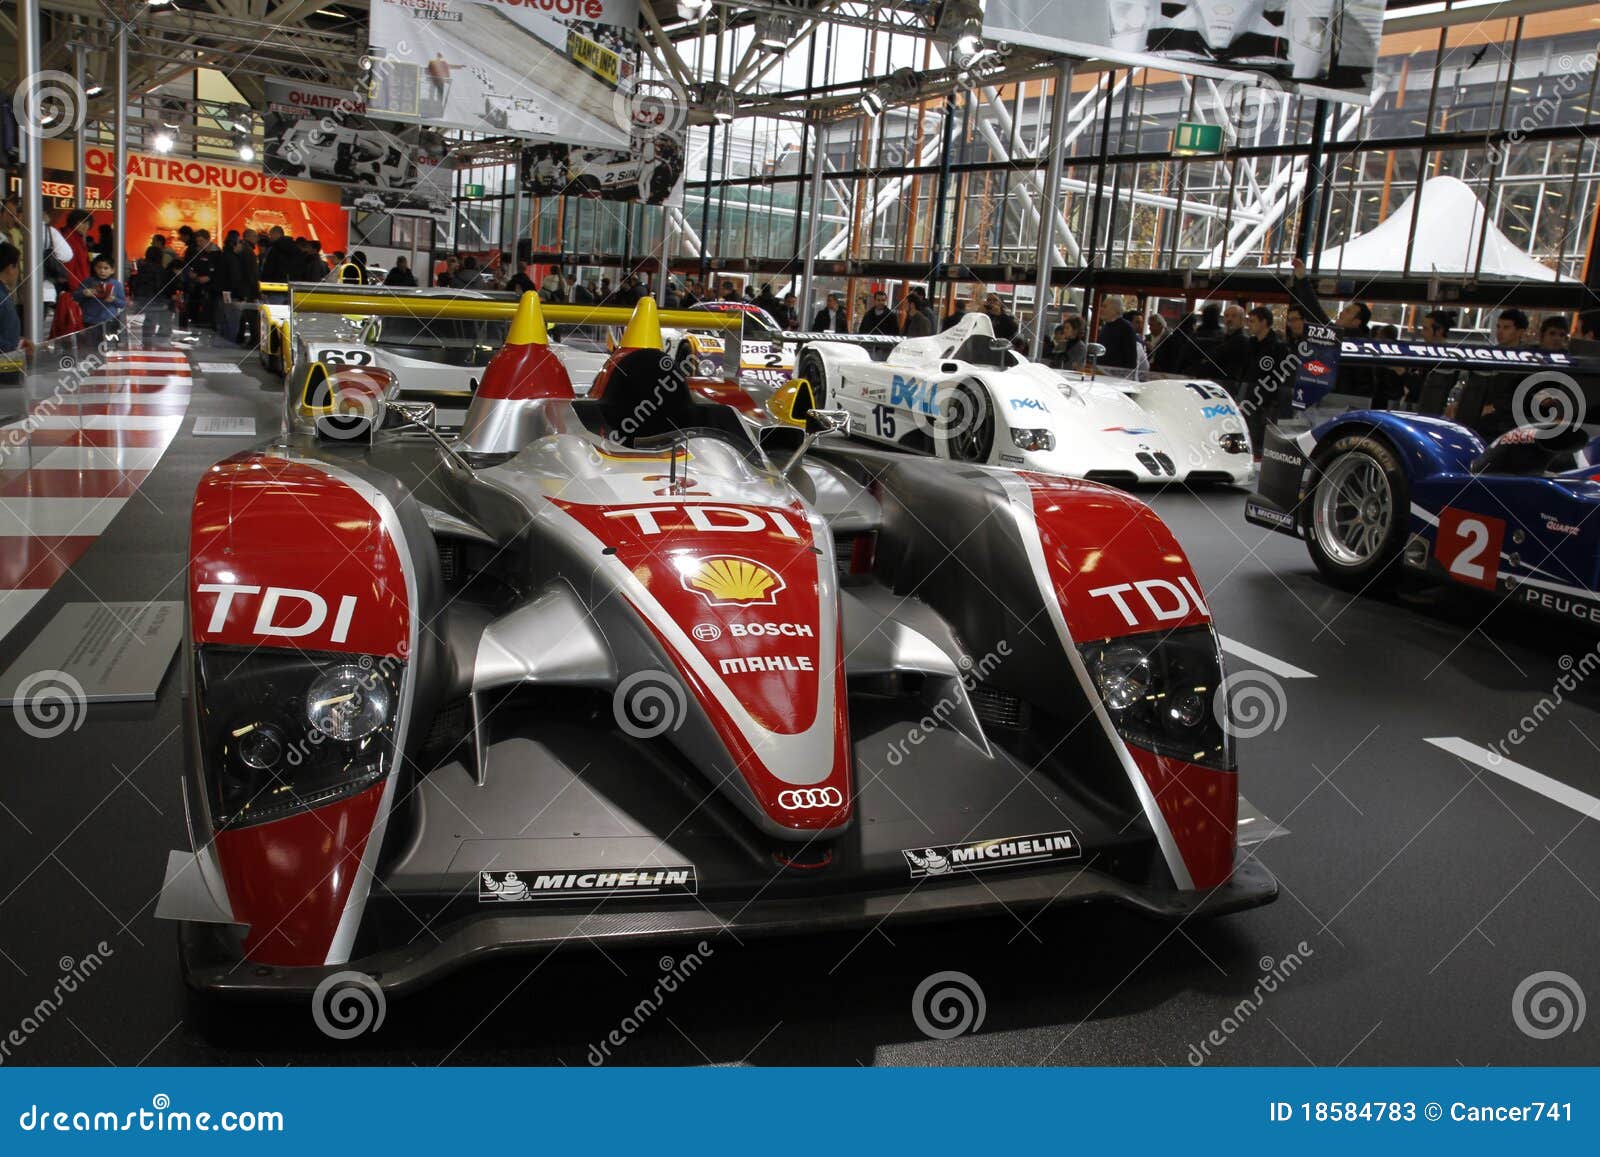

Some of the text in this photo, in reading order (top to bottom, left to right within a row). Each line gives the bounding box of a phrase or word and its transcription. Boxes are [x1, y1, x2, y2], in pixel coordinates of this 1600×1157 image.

[86, 199, 112, 209] MANS
[764, 354, 783, 368] 2
[742, 369, 787, 381] Silk
[872, 403, 896, 438] 15
[603, 506, 801, 540] TDI
[1450, 518, 1489, 580] 2
[1088, 576, 1211, 627] TDI
[197, 583, 358, 644] TDI
[730, 622, 814, 638] BOSCH
[719, 655, 814, 675] MAHLE
[952, 836, 1072, 863] MICHELIN
[533, 870, 689, 890] MICHELIN
